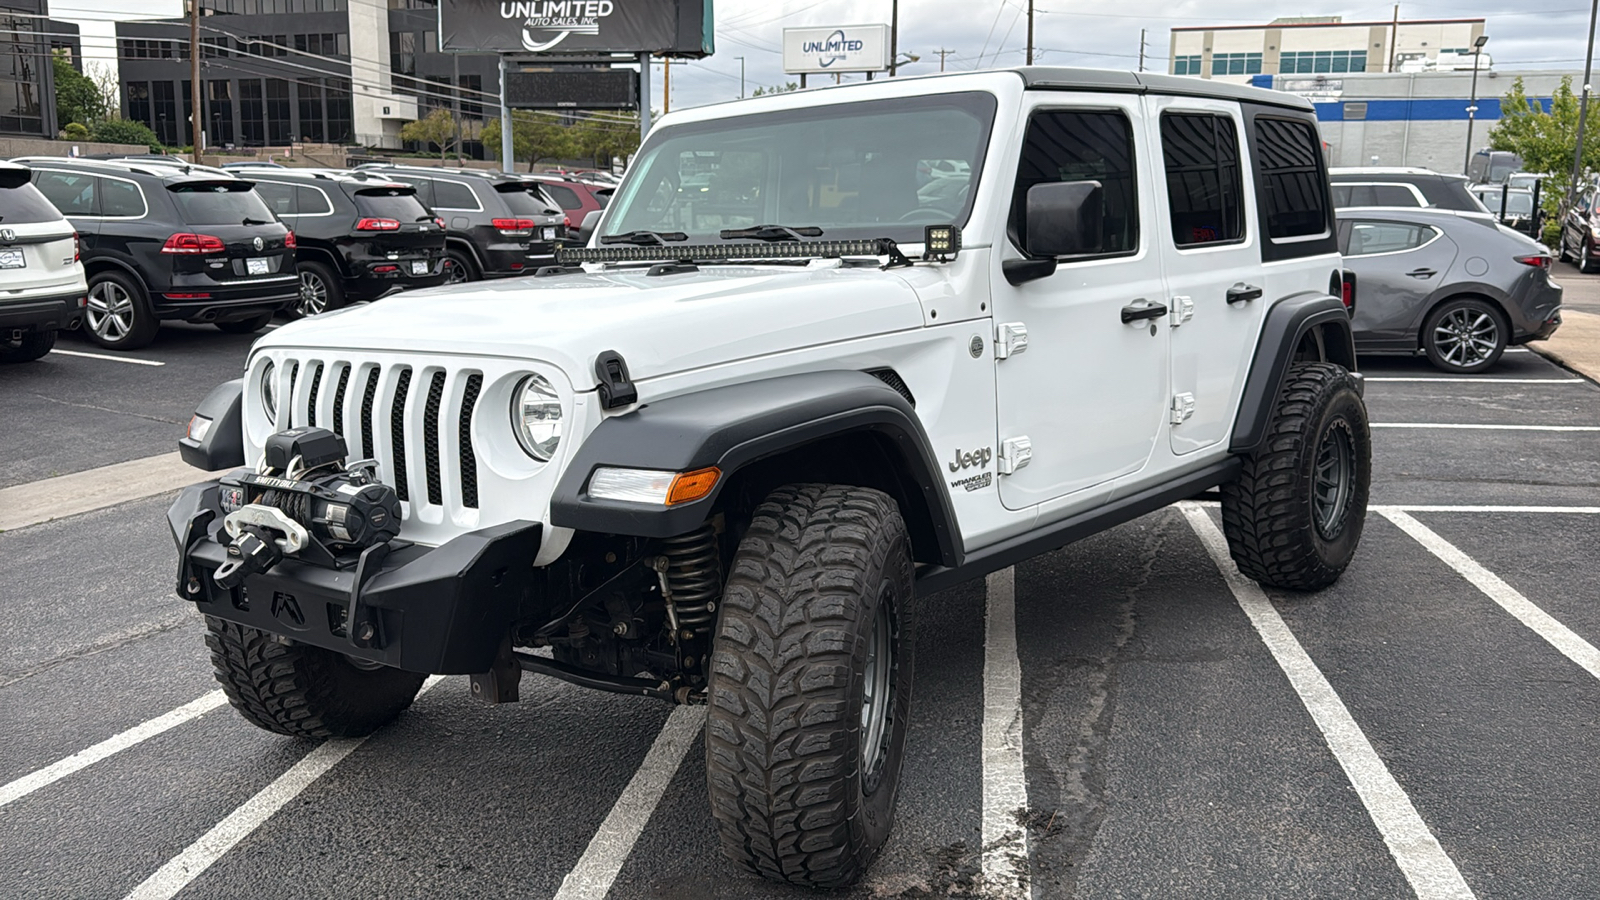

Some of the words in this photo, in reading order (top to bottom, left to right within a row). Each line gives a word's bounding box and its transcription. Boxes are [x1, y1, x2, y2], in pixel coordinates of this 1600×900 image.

[500, 0, 614, 19] UNLIMITED
[524, 18, 550, 26] AUTO
[580, 17, 599, 25] INC.
[803, 40, 863, 53] UNLIMITED
[949, 446, 992, 472] Jeep
[254, 476, 298, 489] SMITTYBILT
[951, 471, 992, 488] WRANGLER
